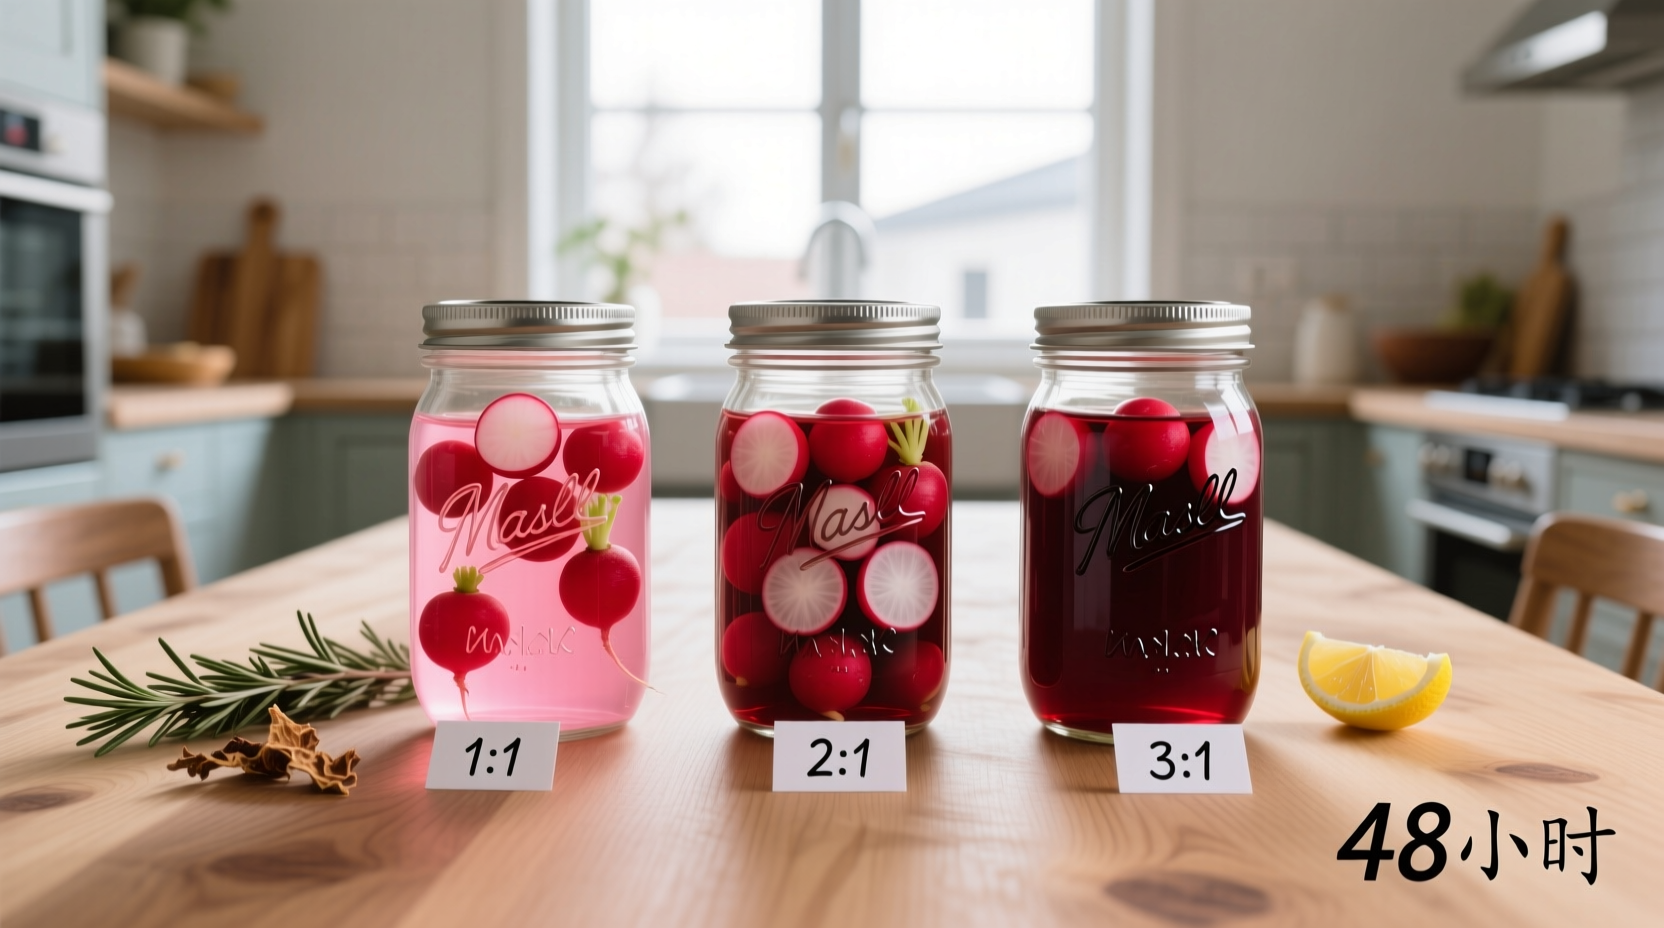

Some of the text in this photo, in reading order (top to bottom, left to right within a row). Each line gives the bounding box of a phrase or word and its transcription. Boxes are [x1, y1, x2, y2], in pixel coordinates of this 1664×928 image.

[465, 737, 521, 777] 1:1
[807, 738, 870, 778] 2:1
[1149, 740, 1210, 781] 3:1
